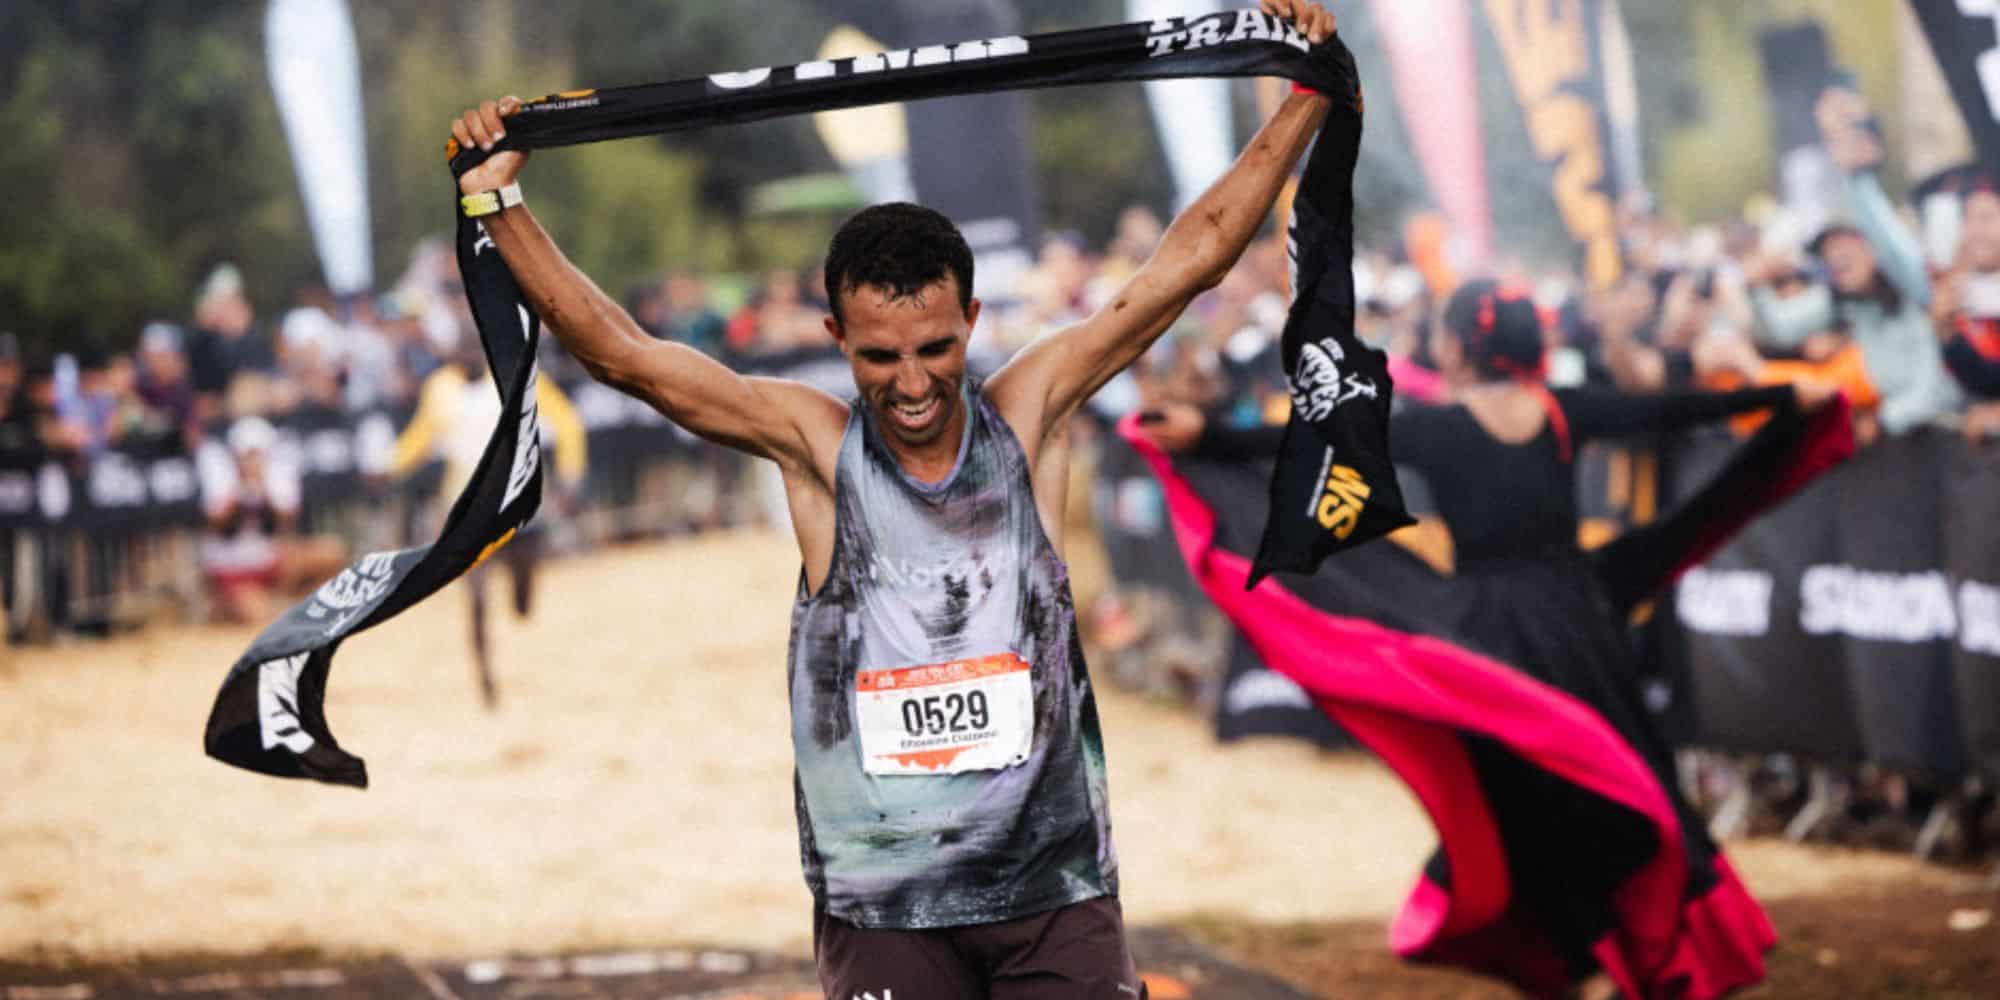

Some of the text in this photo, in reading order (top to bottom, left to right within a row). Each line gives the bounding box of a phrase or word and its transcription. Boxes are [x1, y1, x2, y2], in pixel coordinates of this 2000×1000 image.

[1145, 8, 1310, 57] TRAIL
[1316, 463, 1371, 539] WS
[902, 690, 989, 736] 0529
